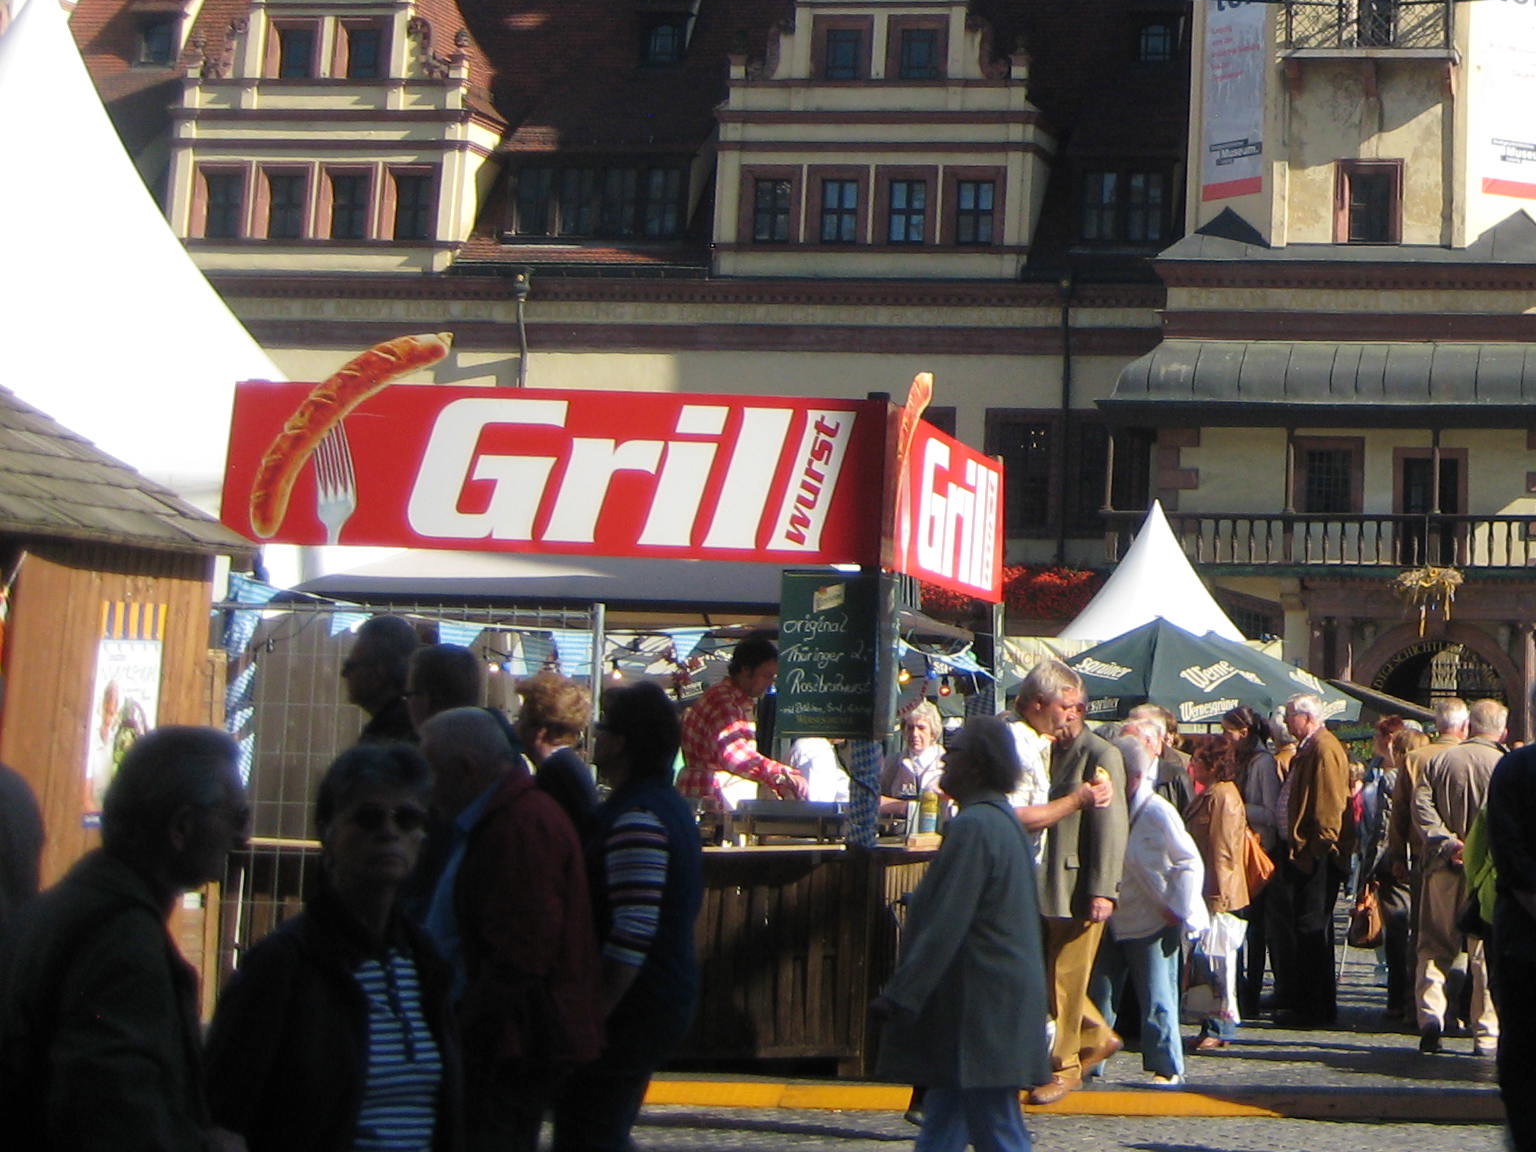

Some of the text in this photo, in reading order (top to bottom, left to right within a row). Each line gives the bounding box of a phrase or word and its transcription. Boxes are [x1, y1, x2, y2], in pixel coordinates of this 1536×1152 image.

[407, 397, 794, 550] Grill
[783, 414, 843, 548] wurst
[917, 436, 988, 587] Grill
